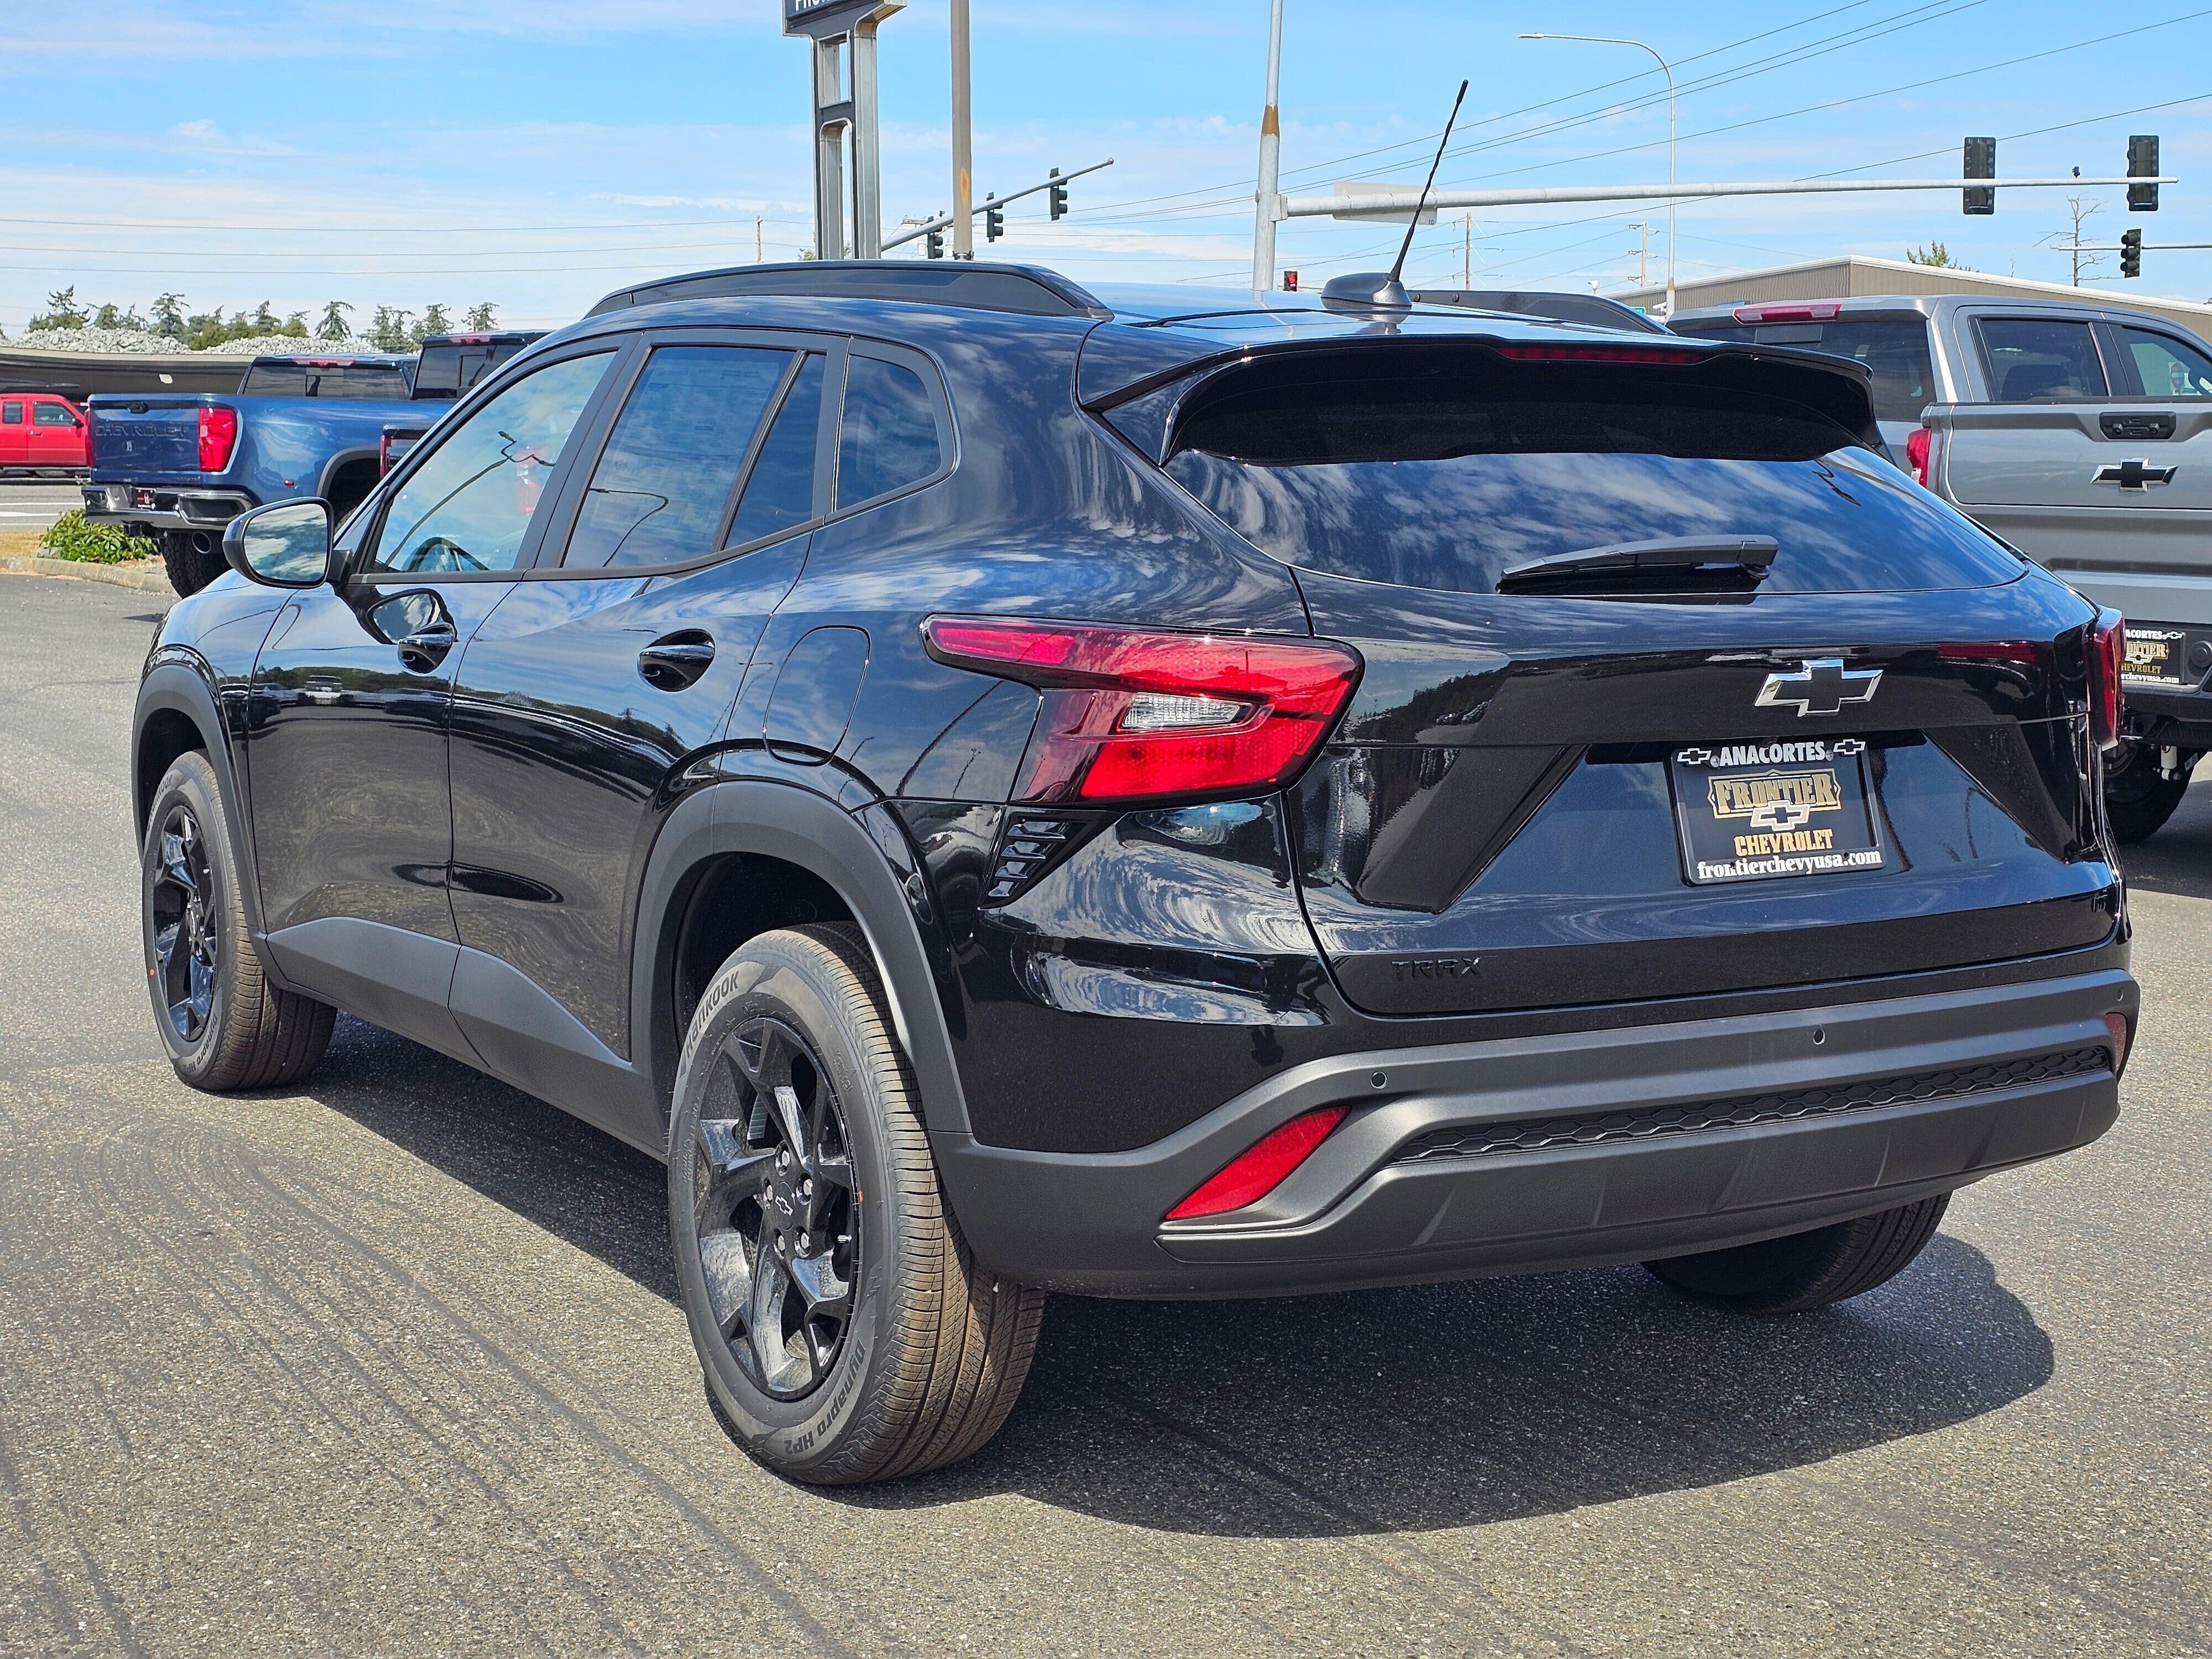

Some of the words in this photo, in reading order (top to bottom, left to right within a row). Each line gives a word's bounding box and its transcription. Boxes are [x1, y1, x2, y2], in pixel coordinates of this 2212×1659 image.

[95, 425, 189, 437] CHEVROLET
[2125, 629, 2163, 640] ACORTES
[2126, 643, 2166, 658] ONTIER
[2121, 663, 2162, 674] HEVROLET
[1719, 742, 1825, 766] ANACORTES
[1714, 773, 1838, 814] FRONTIER
[1734, 829, 1833, 857] CHEVROLET
[1698, 851, 1882, 880] frontierchevyusa.com
[1391, 956, 1483, 978] TRAX
[784, 1431, 815, 1455] HP2
